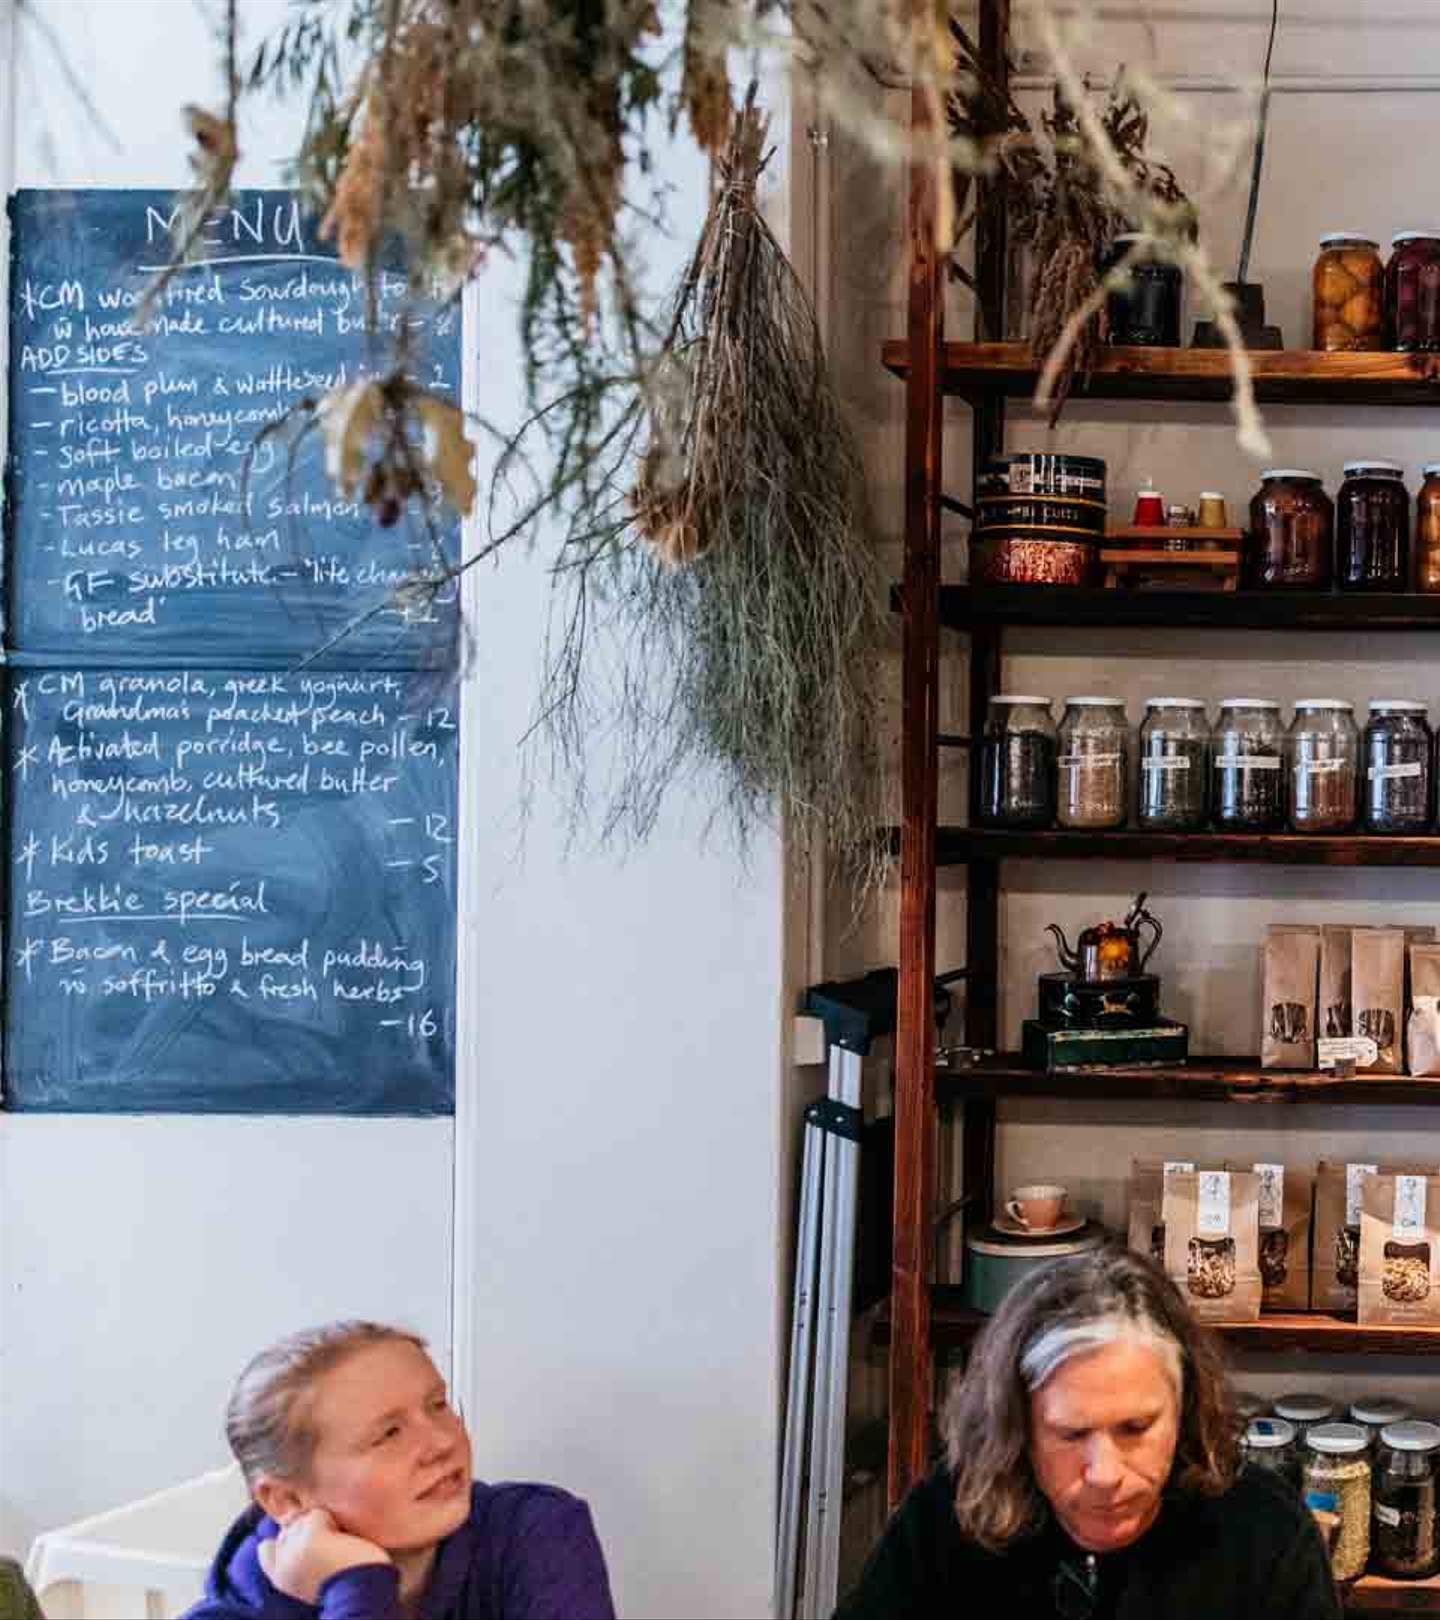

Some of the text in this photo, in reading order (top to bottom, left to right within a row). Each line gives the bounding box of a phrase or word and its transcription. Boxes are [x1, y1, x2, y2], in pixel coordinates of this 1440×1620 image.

[39, 279, 85, 312] CM
[218, 305, 323, 336] cultured
[20, 343, 71, 373] ADD
[62, 377, 132, 408] blood
[143, 371, 198, 405] plum
[131, 430, 213, 462] boiled
[58, 464, 236, 504] maple bacon
[58, 490, 360, 528] Tassie smoked salmon
[61, 526, 280, 563] Lucas leg ham
[64, 568, 115, 601] GF
[38, 671, 85, 697] CM
[224, 673, 288, 710] greek
[311, 703, 385, 733] peach
[426, 708, 456, 729] 12
[47, 730, 160, 768] Activated
[302, 731, 350, 757] bee
[203, 762, 309, 796] cultured
[320, 766, 399, 797] butter
[123, 793, 281, 828] hazelnuts
[425, 814, 454, 843] 12
[129, 832, 214, 865] toast
[421, 853, 442, 884] 5
[163, 880, 268, 926] special
[50, 937, 137, 964] Bacon
[182, 947, 229, 979] egg
[240, 935, 308, 971] bread
[322, 937, 425, 988] pudding
[259, 973, 318, 1000] fresh
[333, 978, 405, 1003] herbs
